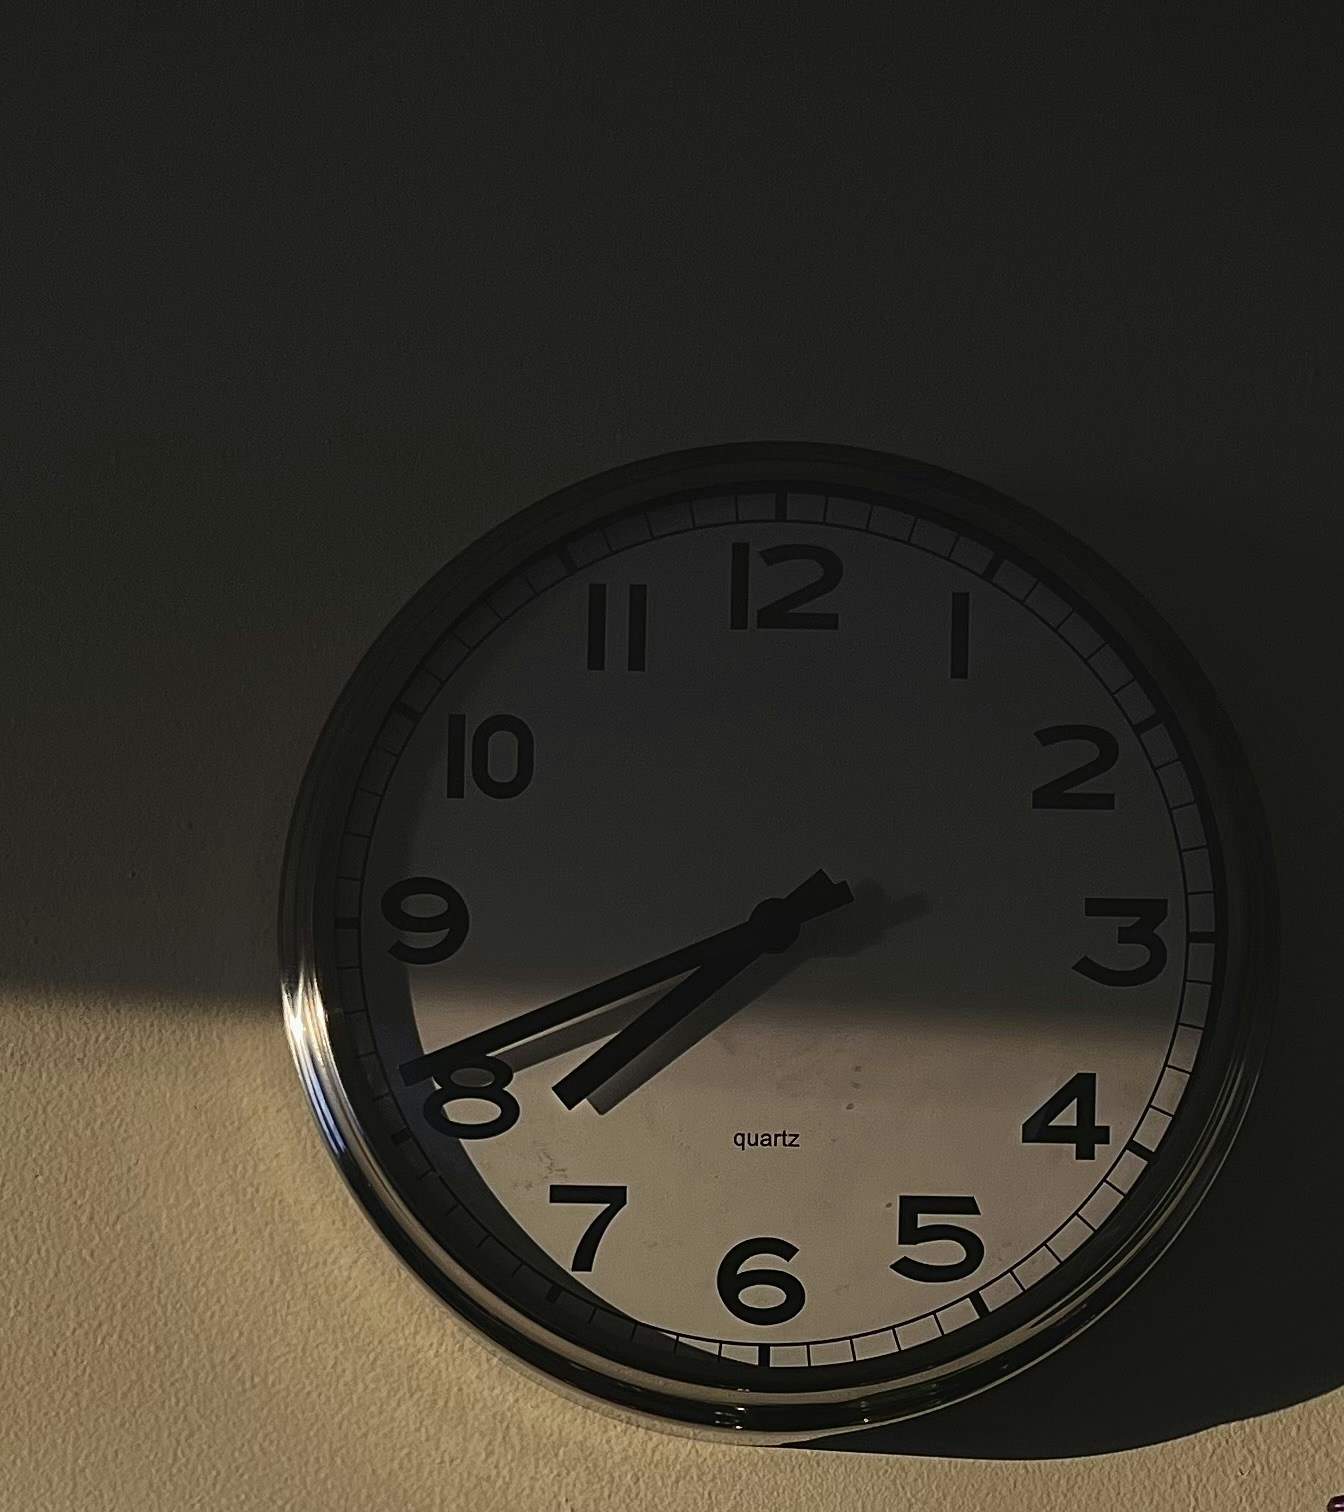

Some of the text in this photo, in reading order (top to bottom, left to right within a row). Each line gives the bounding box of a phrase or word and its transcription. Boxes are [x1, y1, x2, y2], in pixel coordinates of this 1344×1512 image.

[586, 582, 648, 672] 11
[730, 542, 844, 631] 12
[950, 591, 971, 680] 1
[446, 713, 535, 799] 10
[1031, 723, 1120, 810] 2
[379, 876, 470, 965] 9
[1071, 897, 1168, 987] 3
[422, 1053, 521, 1140] 8
[732, 1128, 800, 1152] quartz
[1020, 1072, 1111, 1161] 4
[548, 1183, 628, 1272] 7
[890, 1194, 983, 1283] 5
[716, 1237, 806, 1326] 6
